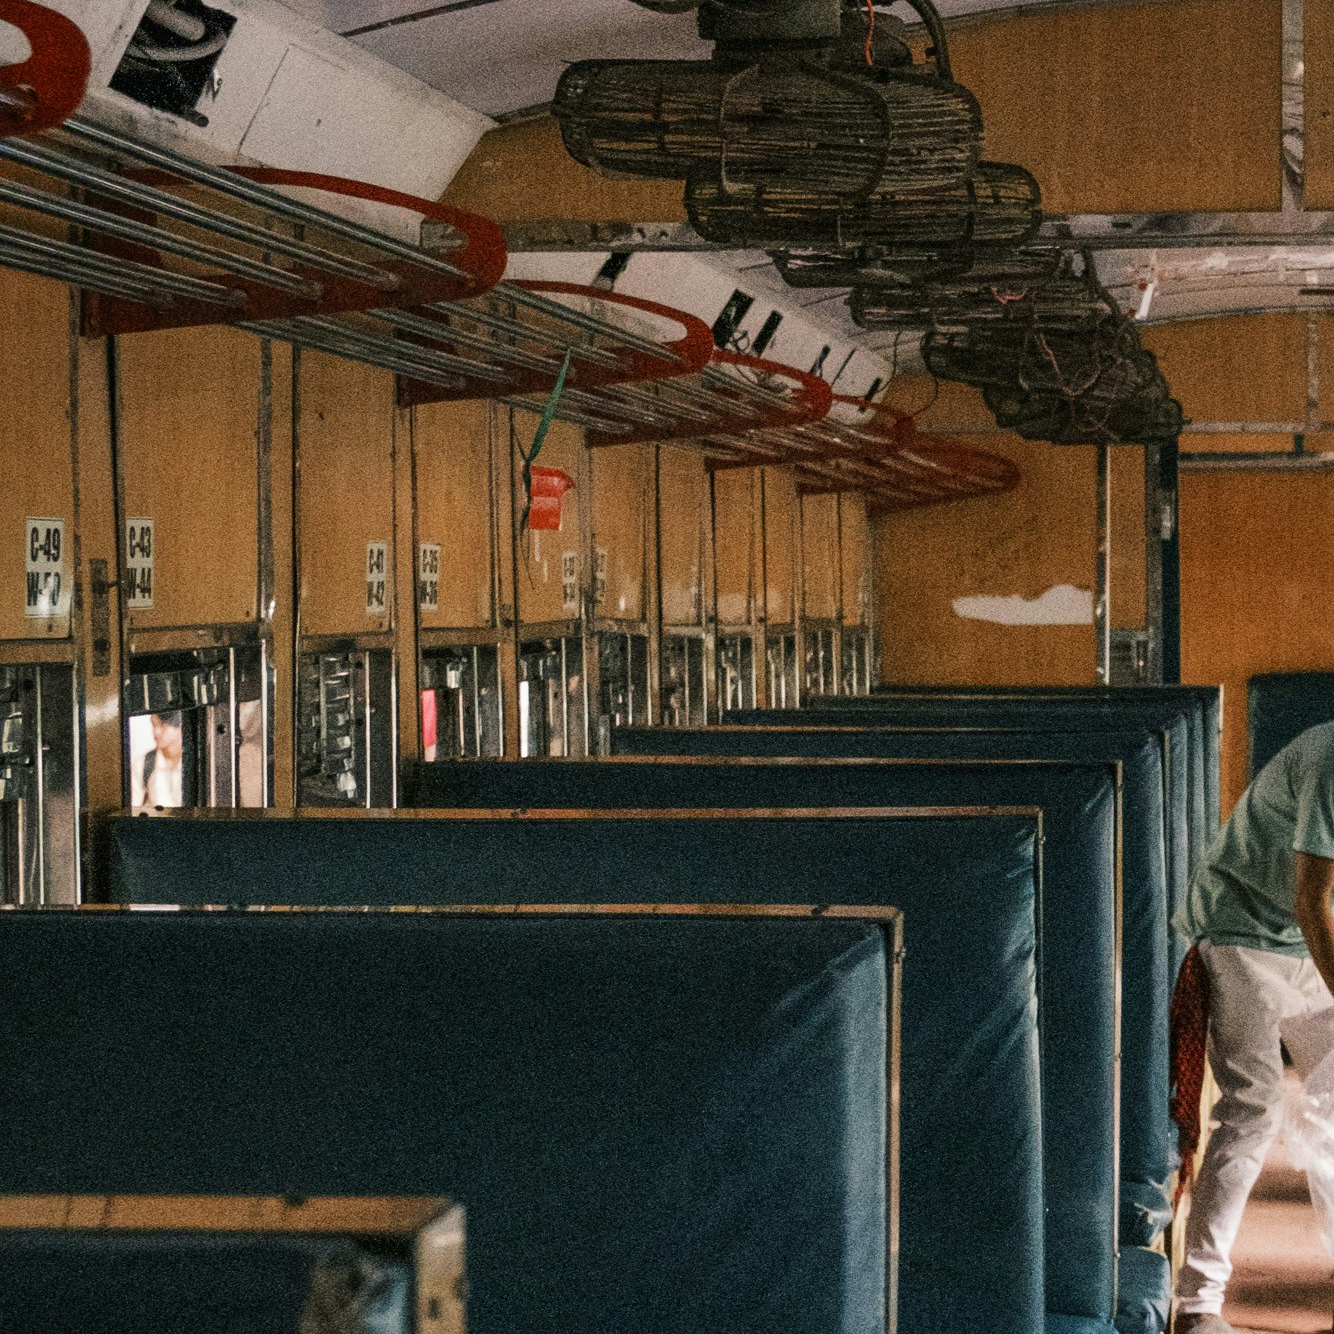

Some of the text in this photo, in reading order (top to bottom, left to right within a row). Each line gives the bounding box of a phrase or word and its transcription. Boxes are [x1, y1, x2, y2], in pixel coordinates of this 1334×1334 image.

[30, 526, 61, 563] C-49
[129, 525, 152, 559] C-43
[125, 567, 151, 599] W-44
